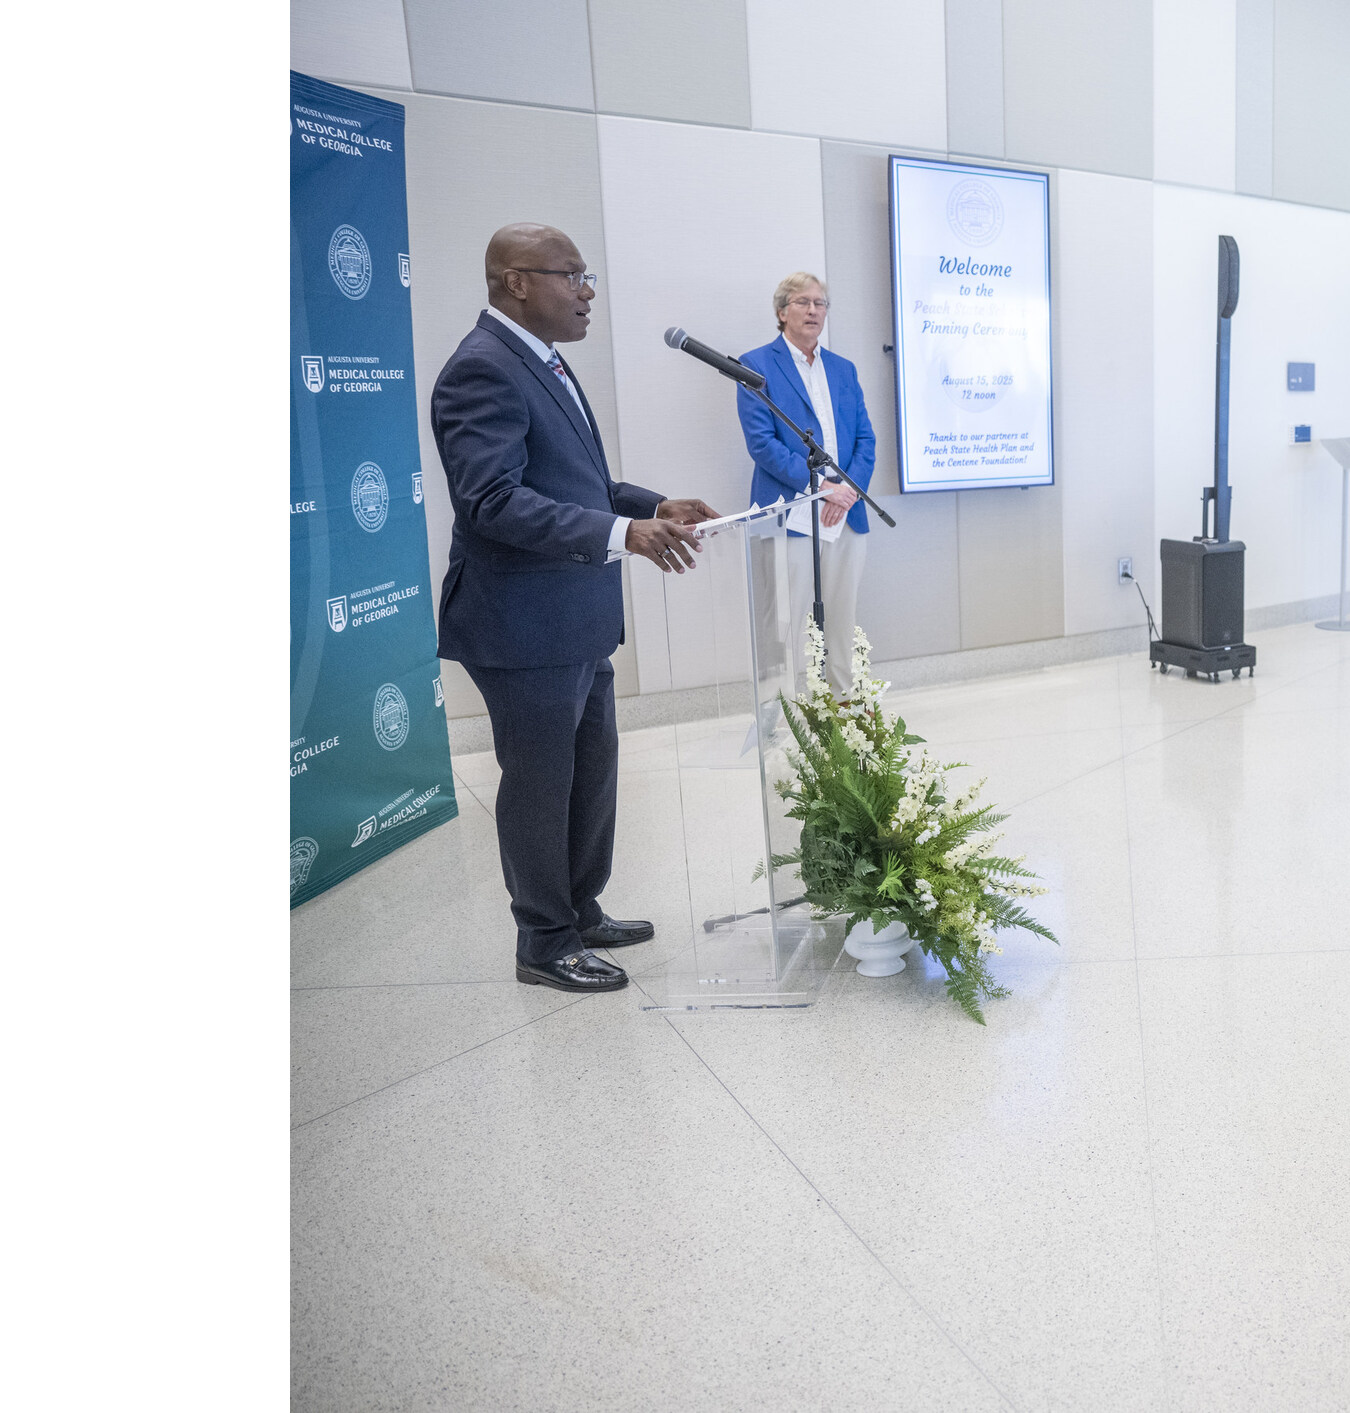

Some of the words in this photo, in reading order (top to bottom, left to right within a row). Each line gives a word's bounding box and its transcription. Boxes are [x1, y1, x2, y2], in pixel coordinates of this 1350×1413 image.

[293, 104, 322, 119] AUGUSTA
[322, 113, 361, 128] UNIVERSITY
[296, 118, 349, 140] MEDICAL
[350, 132, 393, 152] COLLEGE
[301, 134, 316, 144] OF
[319, 137, 363, 157] GEORGIA
[939, 256, 1012, 278] Welcome
[959, 284, 971, 296] to
[975, 283, 994, 297] the
[913, 300, 950, 314] Peach
[921, 320, 969, 339] Pinning
[352, 356, 379, 364] UNIVERSITY
[329, 369, 369, 379] MEDICAL
[371, 369, 404, 379] COLLEGE
[330, 383, 342, 392] OF
[343, 382, 382, 392] GEORGIA
[941, 375, 974, 388] August
[991, 375, 1014, 386] 2025
[961, 390, 972, 400] 12
[974, 392, 996, 400] noon
[929, 432, 957, 442] Thanks
[960, 433, 968, 441] to
[970, 433, 983, 441] our
[985, 432, 1018, 443] partners
[1020, 432, 1029, 440] at
[923, 445, 948, 456] Peach
[950, 444, 971, 455] State
[973, 443, 998, 454] Health
[1000, 442, 1018, 453] Plan
[1020, 442, 1035, 452] and
[932, 458, 945, 468] the
[947, 457, 979, 468] Centene
[980, 454, 1028, 466] Foundation!
[290, 501, 316, 514] LEGE
[350, 588, 371, 599] AUGUSTA
[371, 581, 395, 594] UNIVERSITY
[351, 595, 387, 614] MEDICAL
[388, 585, 419, 605] COLLEGE
[352, 615, 363, 627] OF
[364, 604, 399, 624] GEORGIA
[290, 736, 306, 748] RSITY
[294, 736, 340, 762] COLLEGE
[290, 762, 308, 777] GIA
[378, 802, 396, 817] AUGUSTA
[393, 788, 415, 806] UNIVERSITY
[380, 804, 416, 831] MEDICAL
[412, 784, 440, 809] COLLEGE
